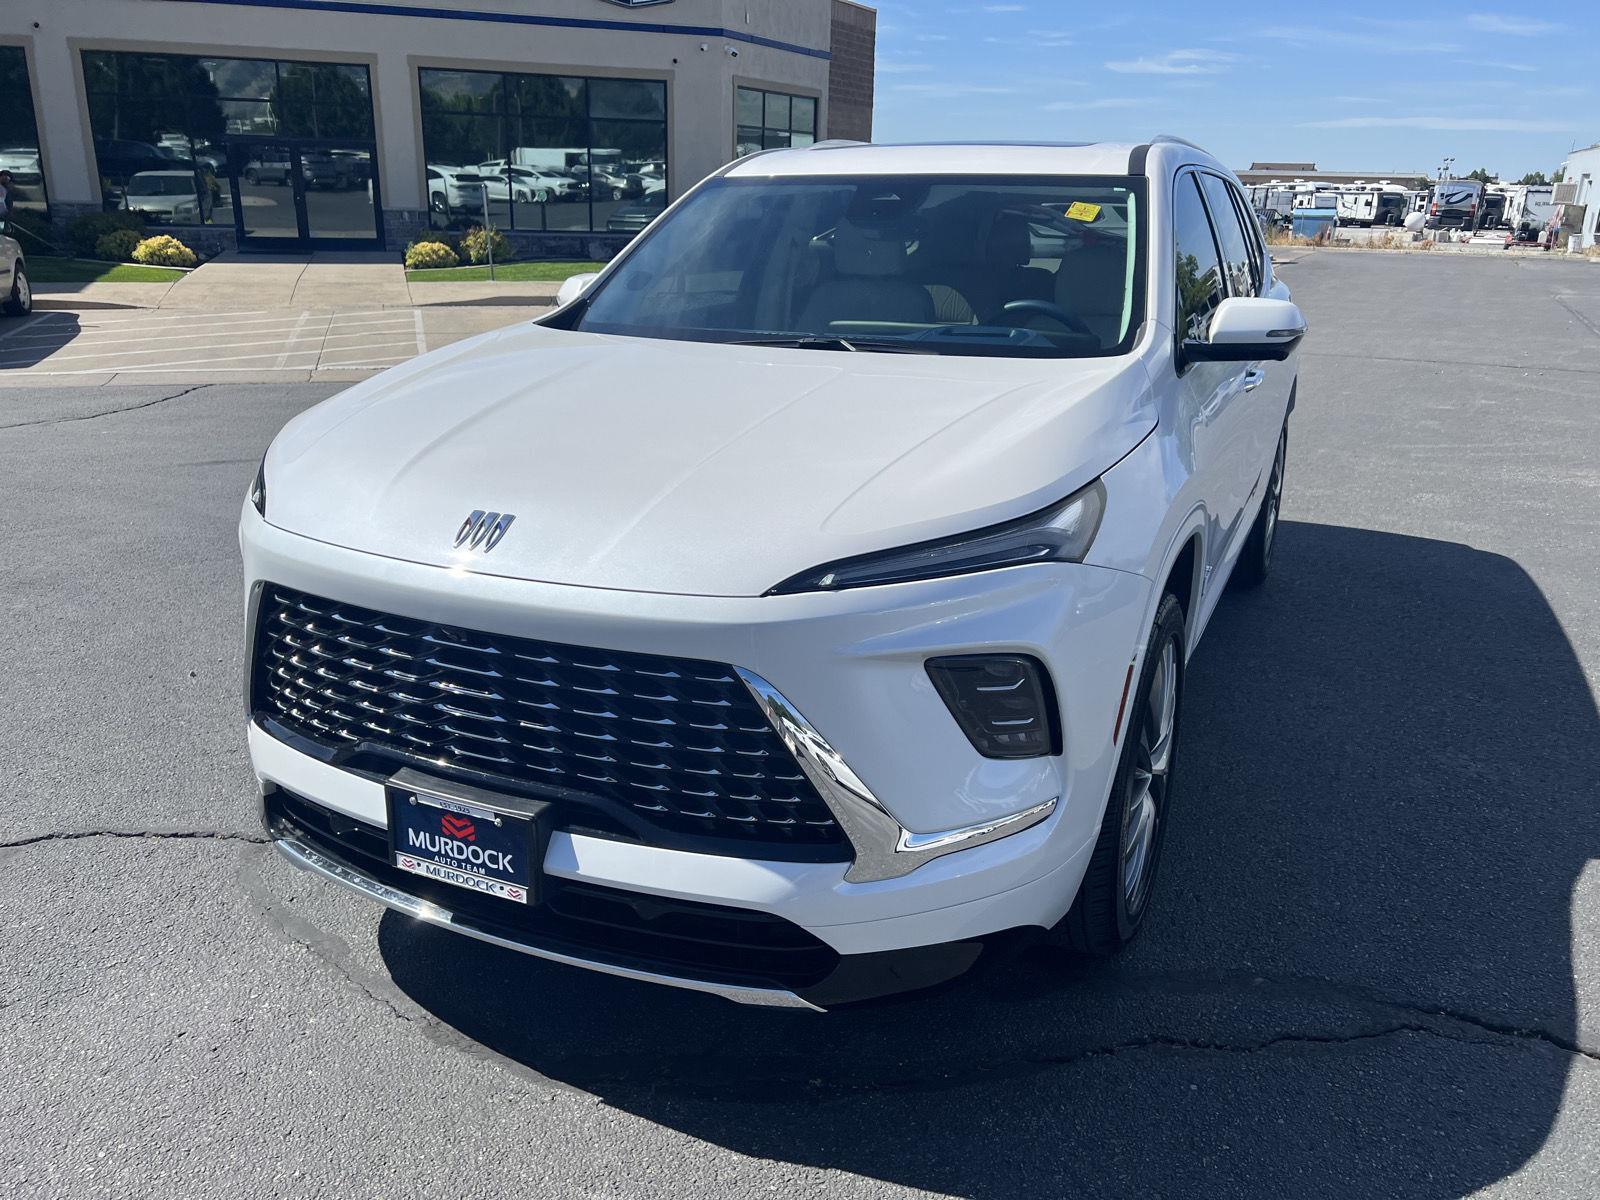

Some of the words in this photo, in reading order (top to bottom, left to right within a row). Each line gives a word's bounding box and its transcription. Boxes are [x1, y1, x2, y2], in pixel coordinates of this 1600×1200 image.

[408, 828, 514, 873] MURDOCK
[434, 855, 458, 867] AUTO
[461, 862, 486, 875] TEAM
[426, 864, 497, 894] MURDOCK
